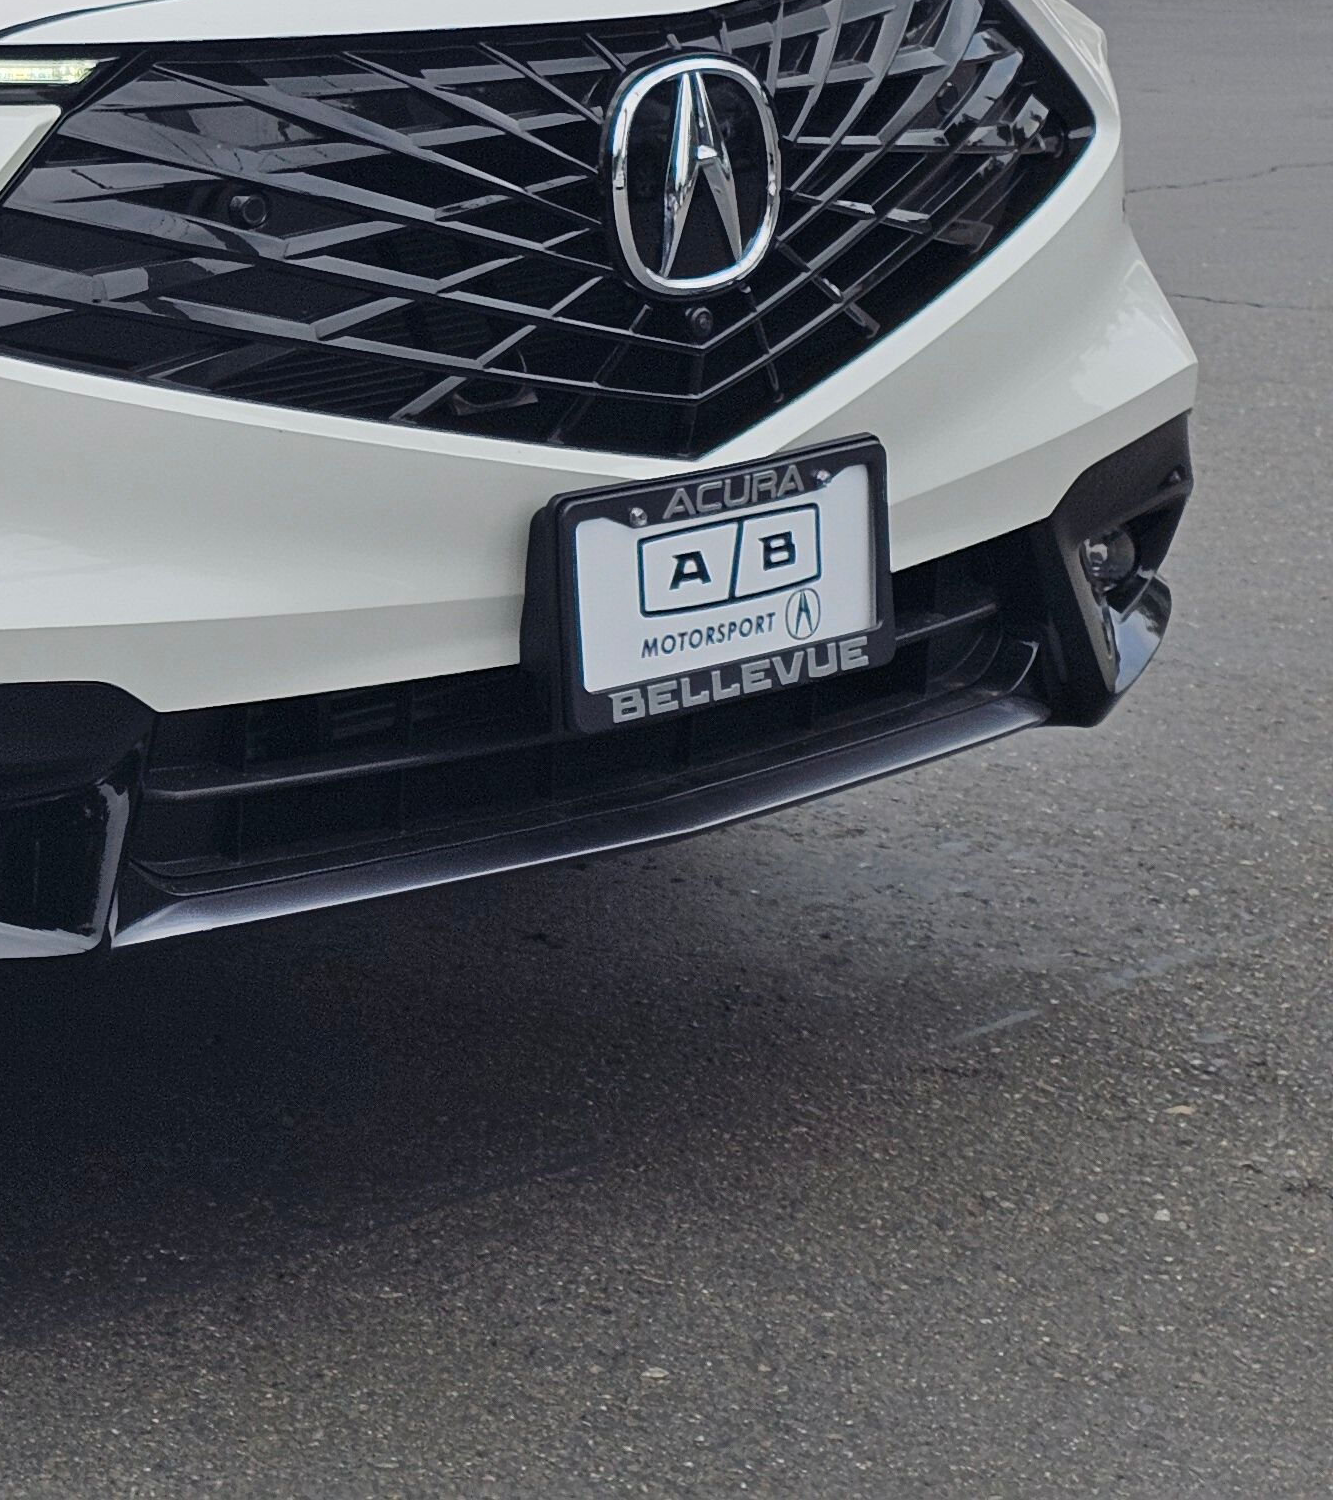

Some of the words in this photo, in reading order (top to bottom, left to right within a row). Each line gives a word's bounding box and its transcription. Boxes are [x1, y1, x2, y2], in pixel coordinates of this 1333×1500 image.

[663, 464, 805, 521] ACURA
[669, 550, 712, 591] A
[759, 531, 797, 572] B
[640, 612, 776, 659] MOTORSPORT
[609, 636, 870, 724] BELLEVUE
